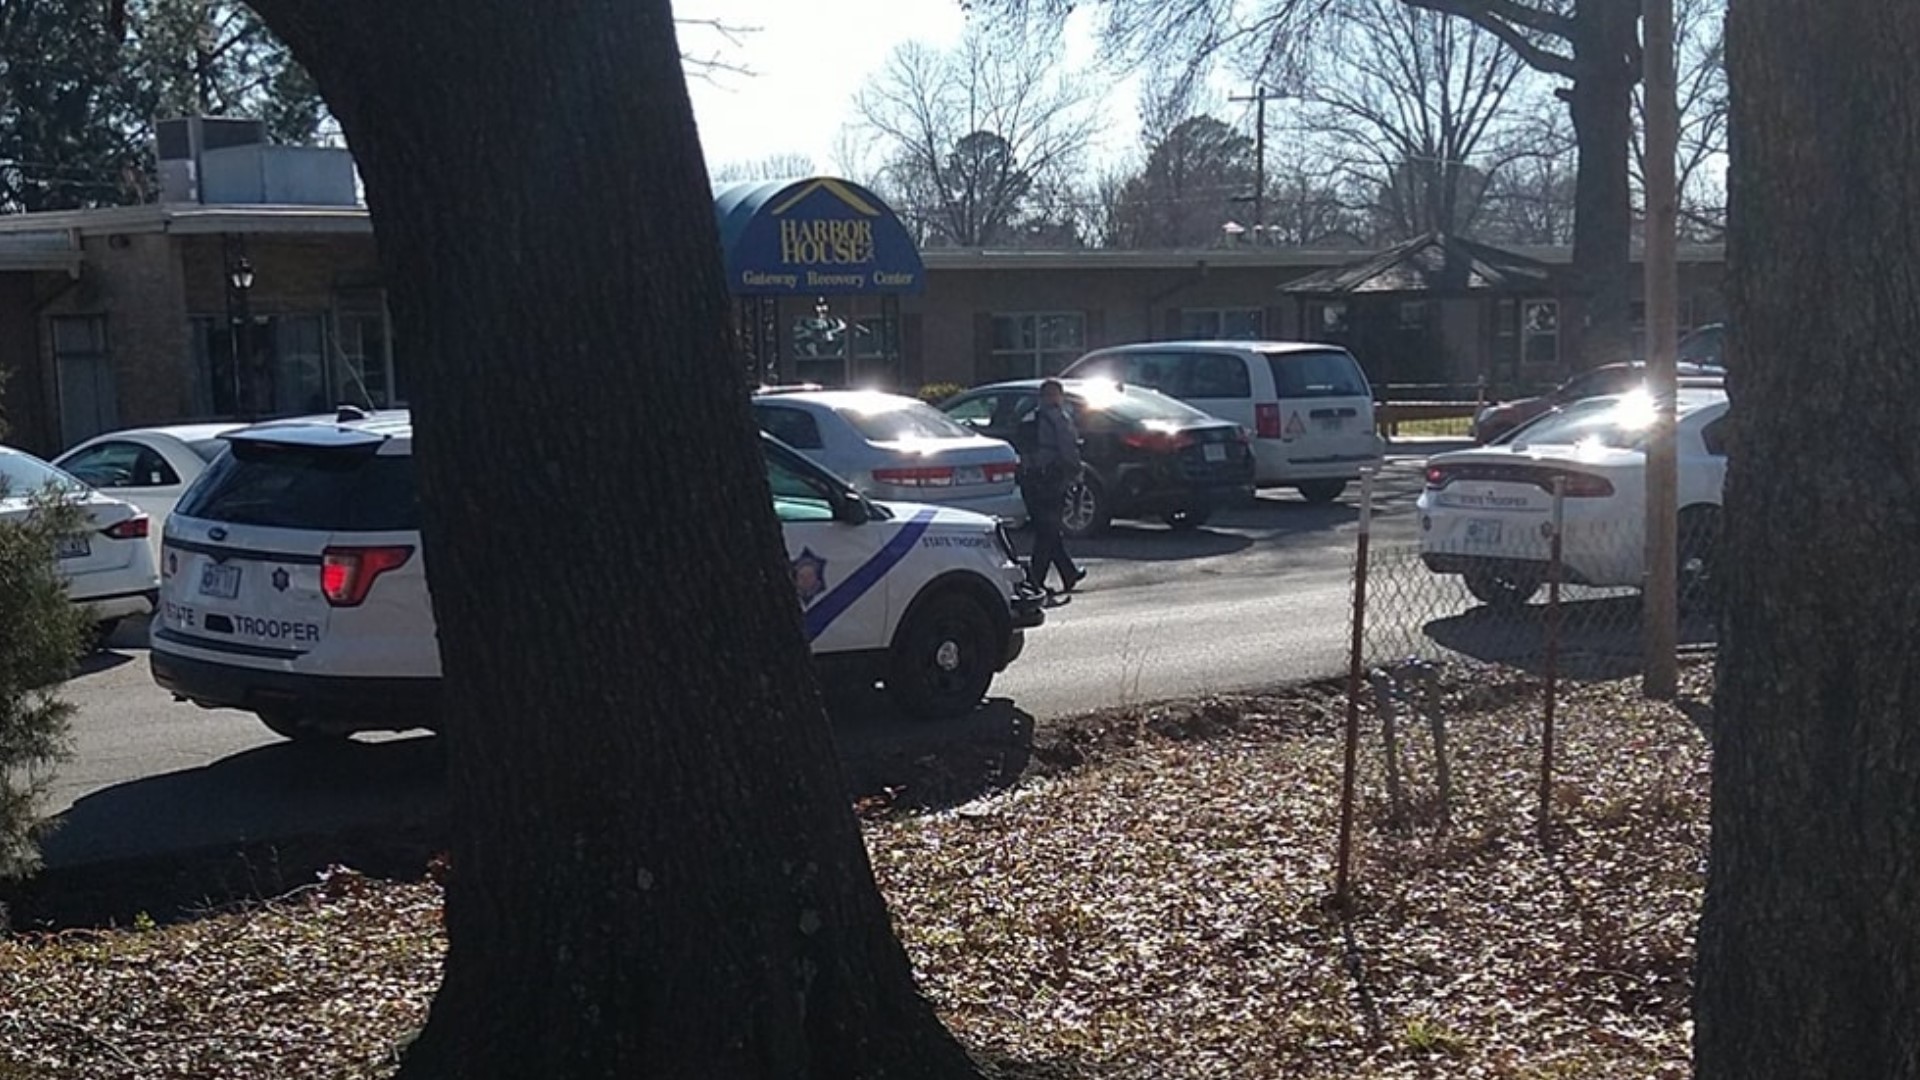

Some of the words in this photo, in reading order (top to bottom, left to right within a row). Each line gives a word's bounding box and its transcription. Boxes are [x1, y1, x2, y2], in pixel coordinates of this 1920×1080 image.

[780, 218, 873, 242] HARBOR
[781, 240, 867, 264] HOUSE
[742, 270, 797, 288] Gateway
[807, 270, 864, 288] Recovery
[873, 270, 915, 285] Center
[1486, 496, 1528, 506] TROOPER
[922, 536, 951, 548] STATE
[165, 602, 195, 626] STATE
[233, 615, 320, 641] TROOPER
